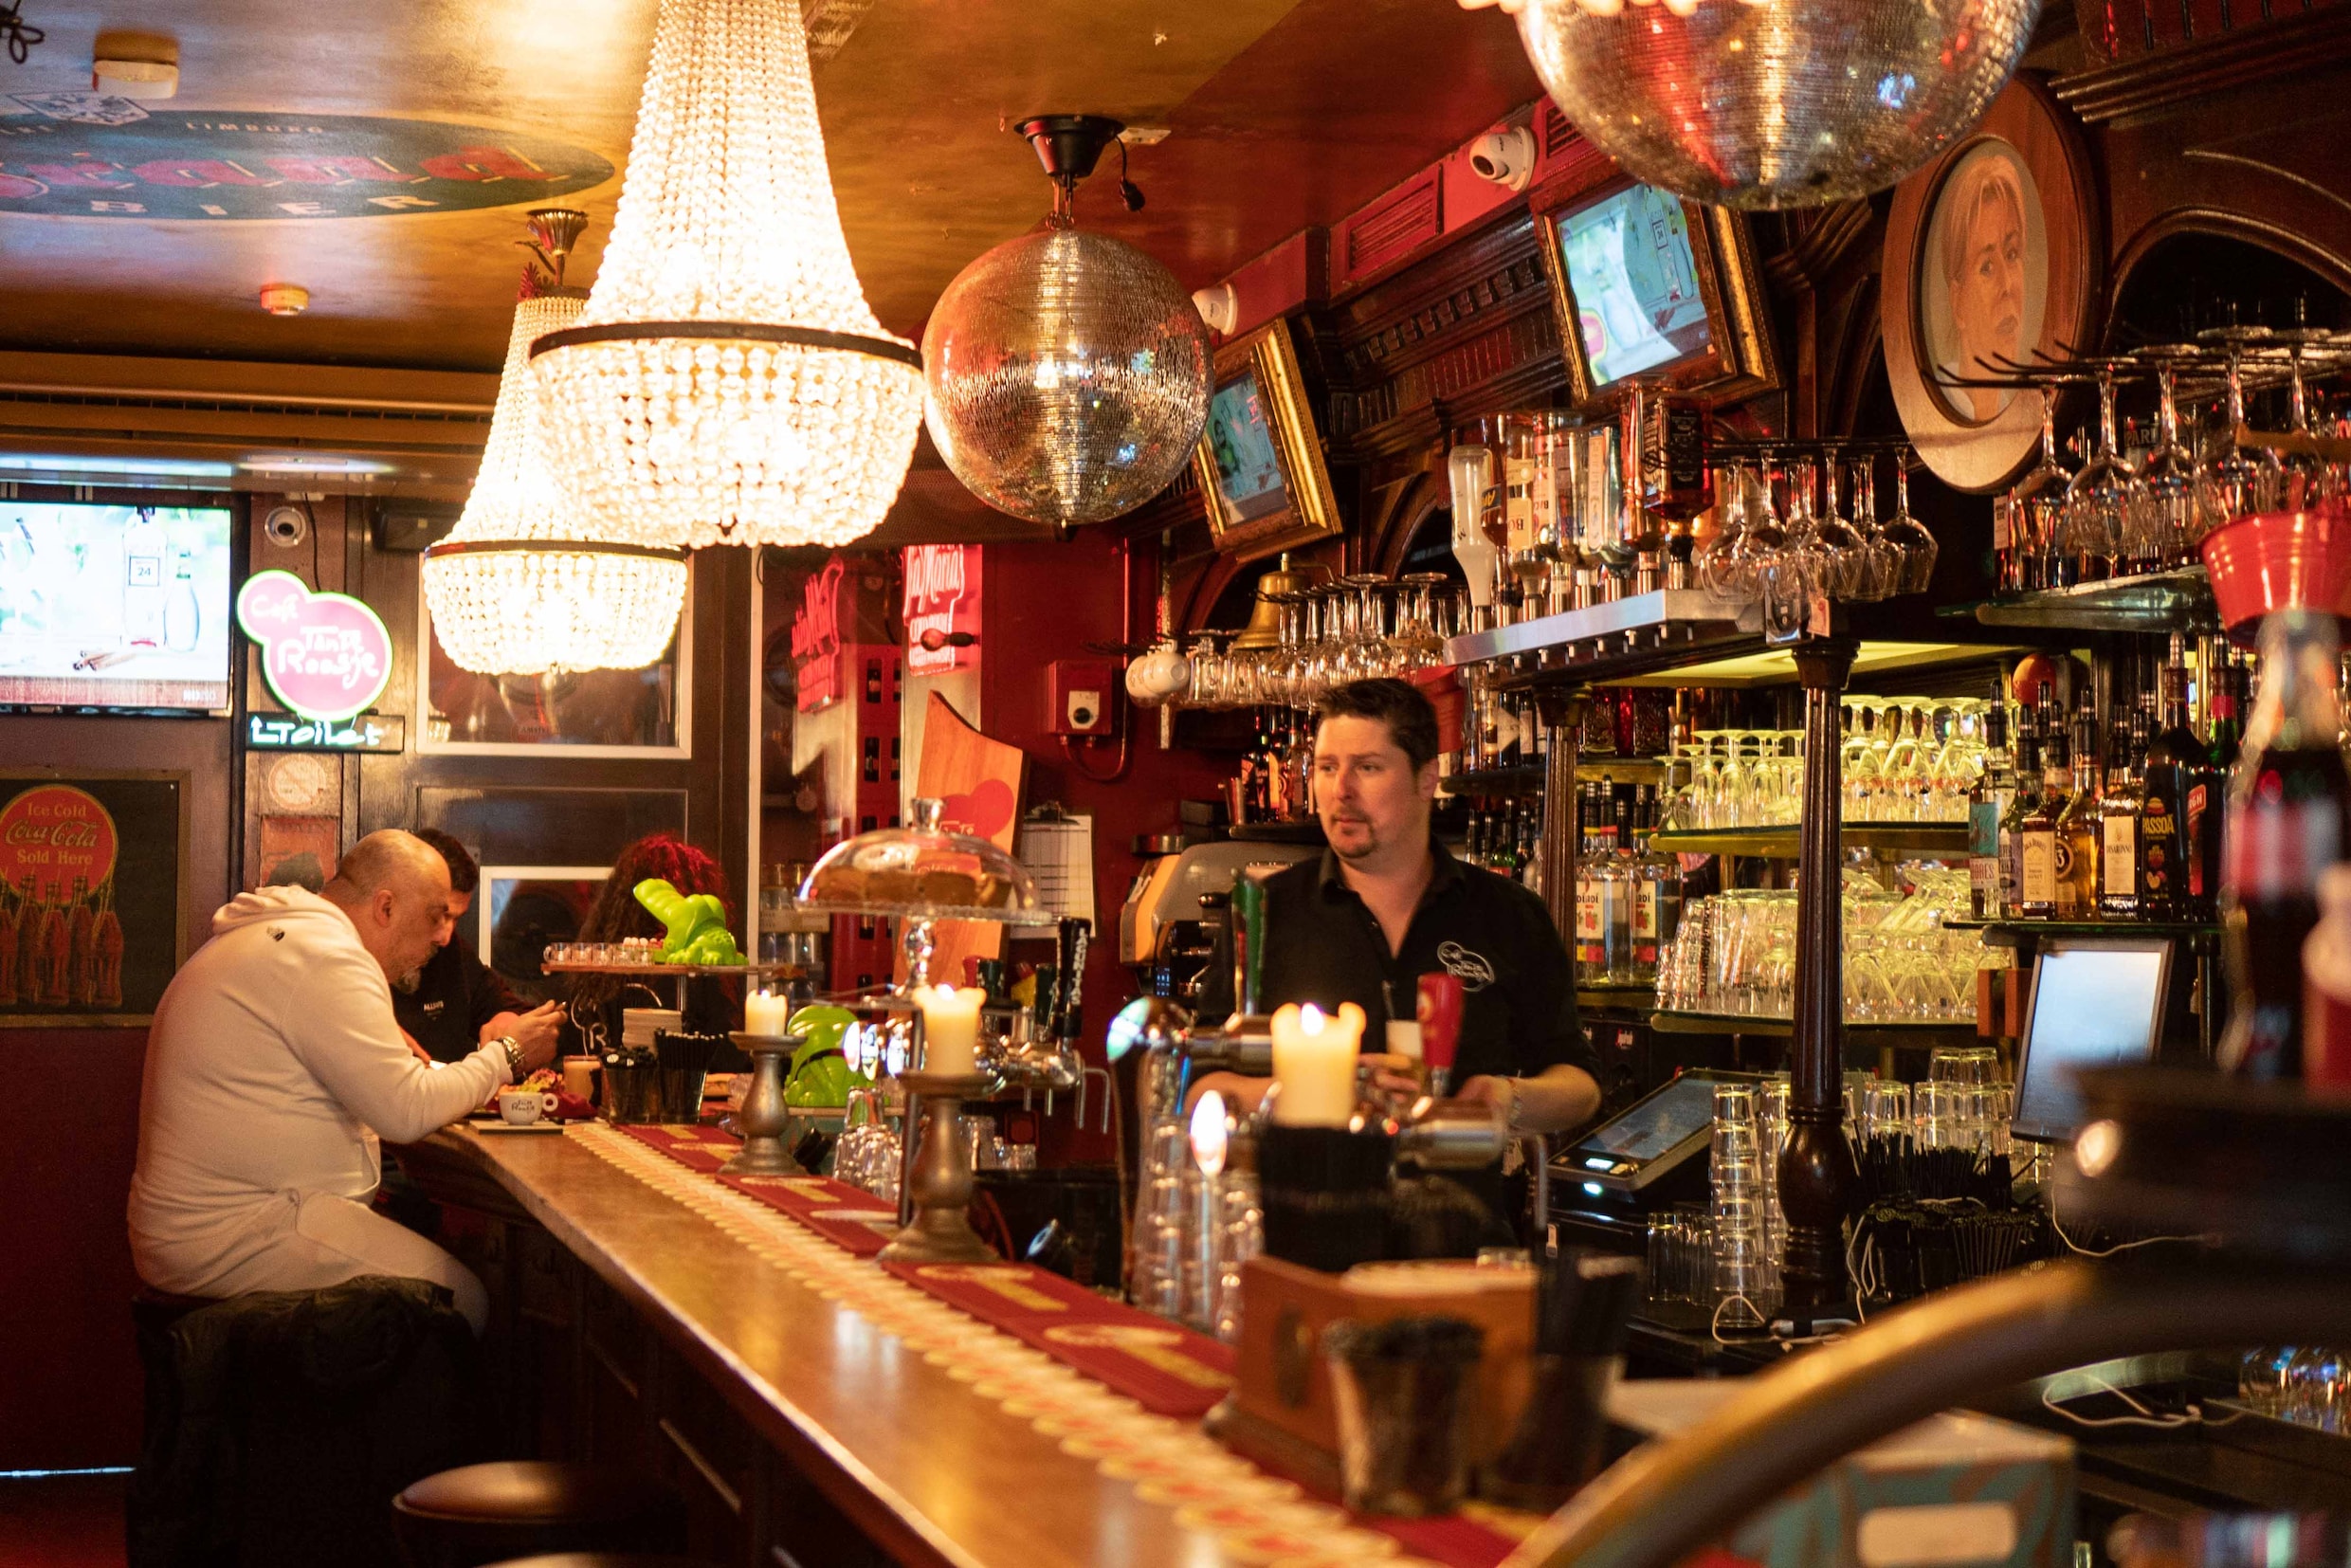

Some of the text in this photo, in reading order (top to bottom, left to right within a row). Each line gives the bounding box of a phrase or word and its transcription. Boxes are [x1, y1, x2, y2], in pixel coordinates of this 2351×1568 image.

[90, 195, 440, 216] BIER
[137, 566, 152, 577] 24
[277, 638, 379, 691] Roosje
[265, 720, 384, 746] Toilet
[27, 803, 87, 819] Ice Cold
[17, 848, 93, 866] Sold Here
[1070, 927, 1089, 1006] LAGUNITAS
